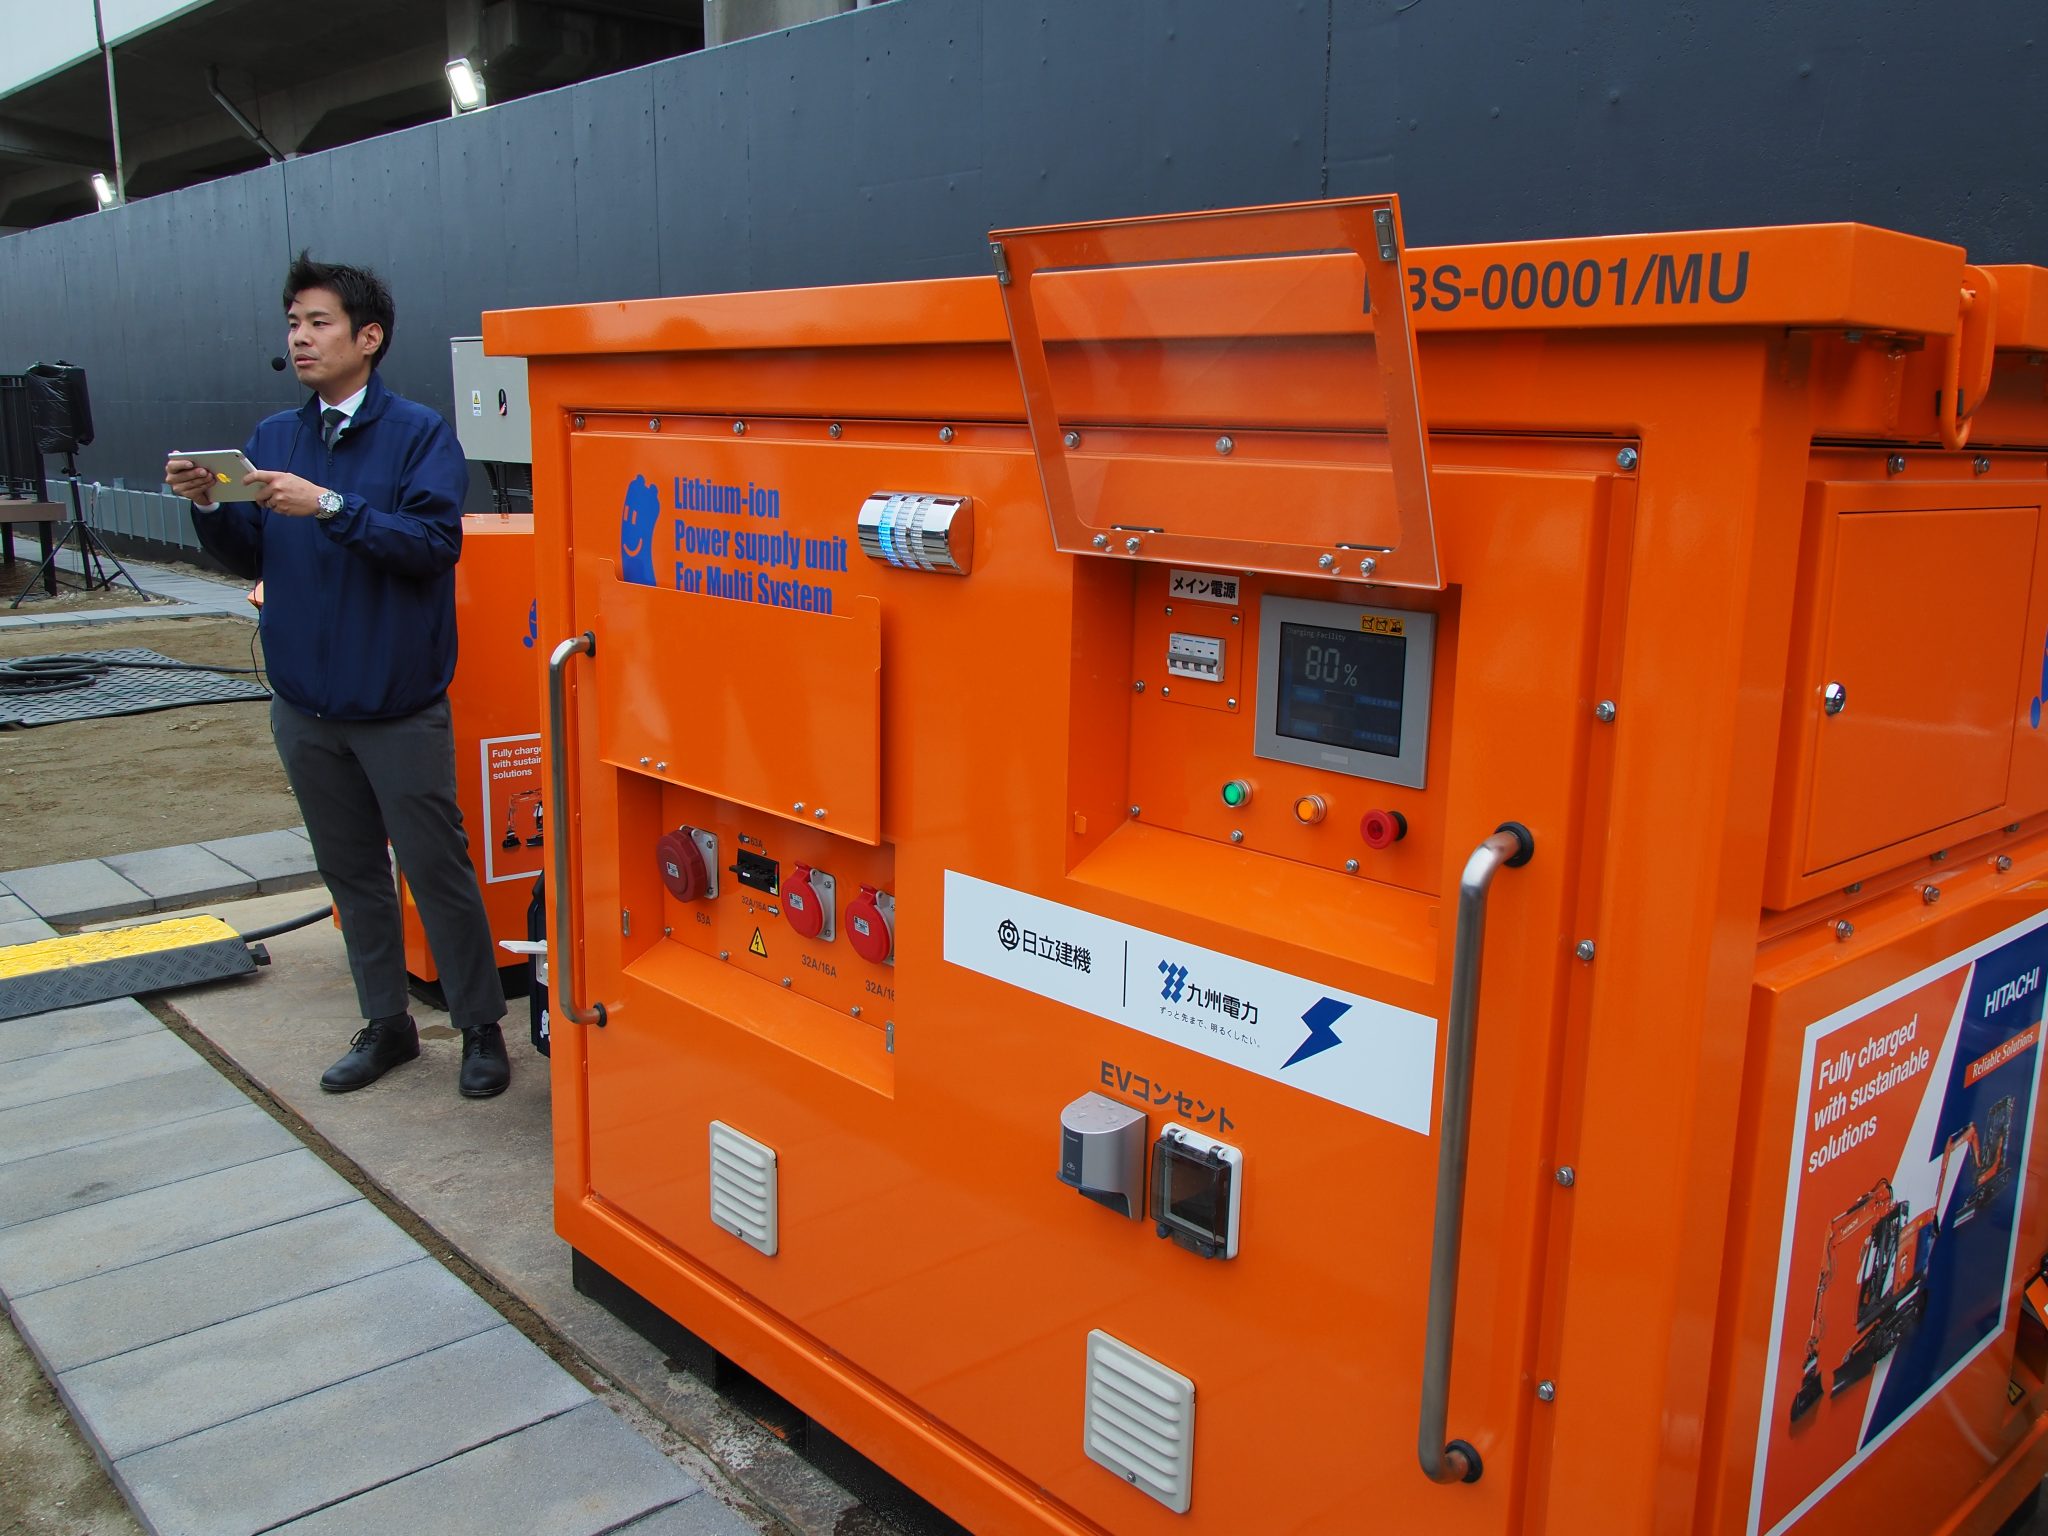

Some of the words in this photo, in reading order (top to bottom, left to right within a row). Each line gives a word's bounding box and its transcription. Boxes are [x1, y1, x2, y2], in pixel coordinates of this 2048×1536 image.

[673, 476, 780, 519] Lithium-ion
[674, 519, 731, 557] Power
[734, 530, 801, 570] supply
[805, 535, 848, 572] unit
[675, 561, 702, 593] For
[706, 565, 753, 602] Multi
[757, 572, 833, 615] System
[1172, 576, 1236, 599] メイン電源
[492, 748, 513, 758] Fully
[492, 760, 511, 769] with
[492, 769, 533, 780] solutions
[696, 912, 712, 927] 63A
[801, 954, 837, 978] 32A/16A
[1022, 929, 1092, 974] 日立建機
[1186, 983, 1259, 1025] 九州電力
[1984, 966, 2040, 1018] HITACHI
[1159, 1006, 1261, 1048] ずっと先まで、明るくしたい。
[1818, 1051, 1856, 1090] Fully
[1857, 1013, 1918, 1069] charged
[1972, 1051, 2002, 1078] Reliable
[2001, 1031, 2034, 1061] Solutions
[1100, 1061, 1235, 1133] EVコンセント
[1813, 1091, 1847, 1132] with
[1850, 1047, 1930, 1111] sustainable
[1808, 1115, 1878, 1173] solutions
